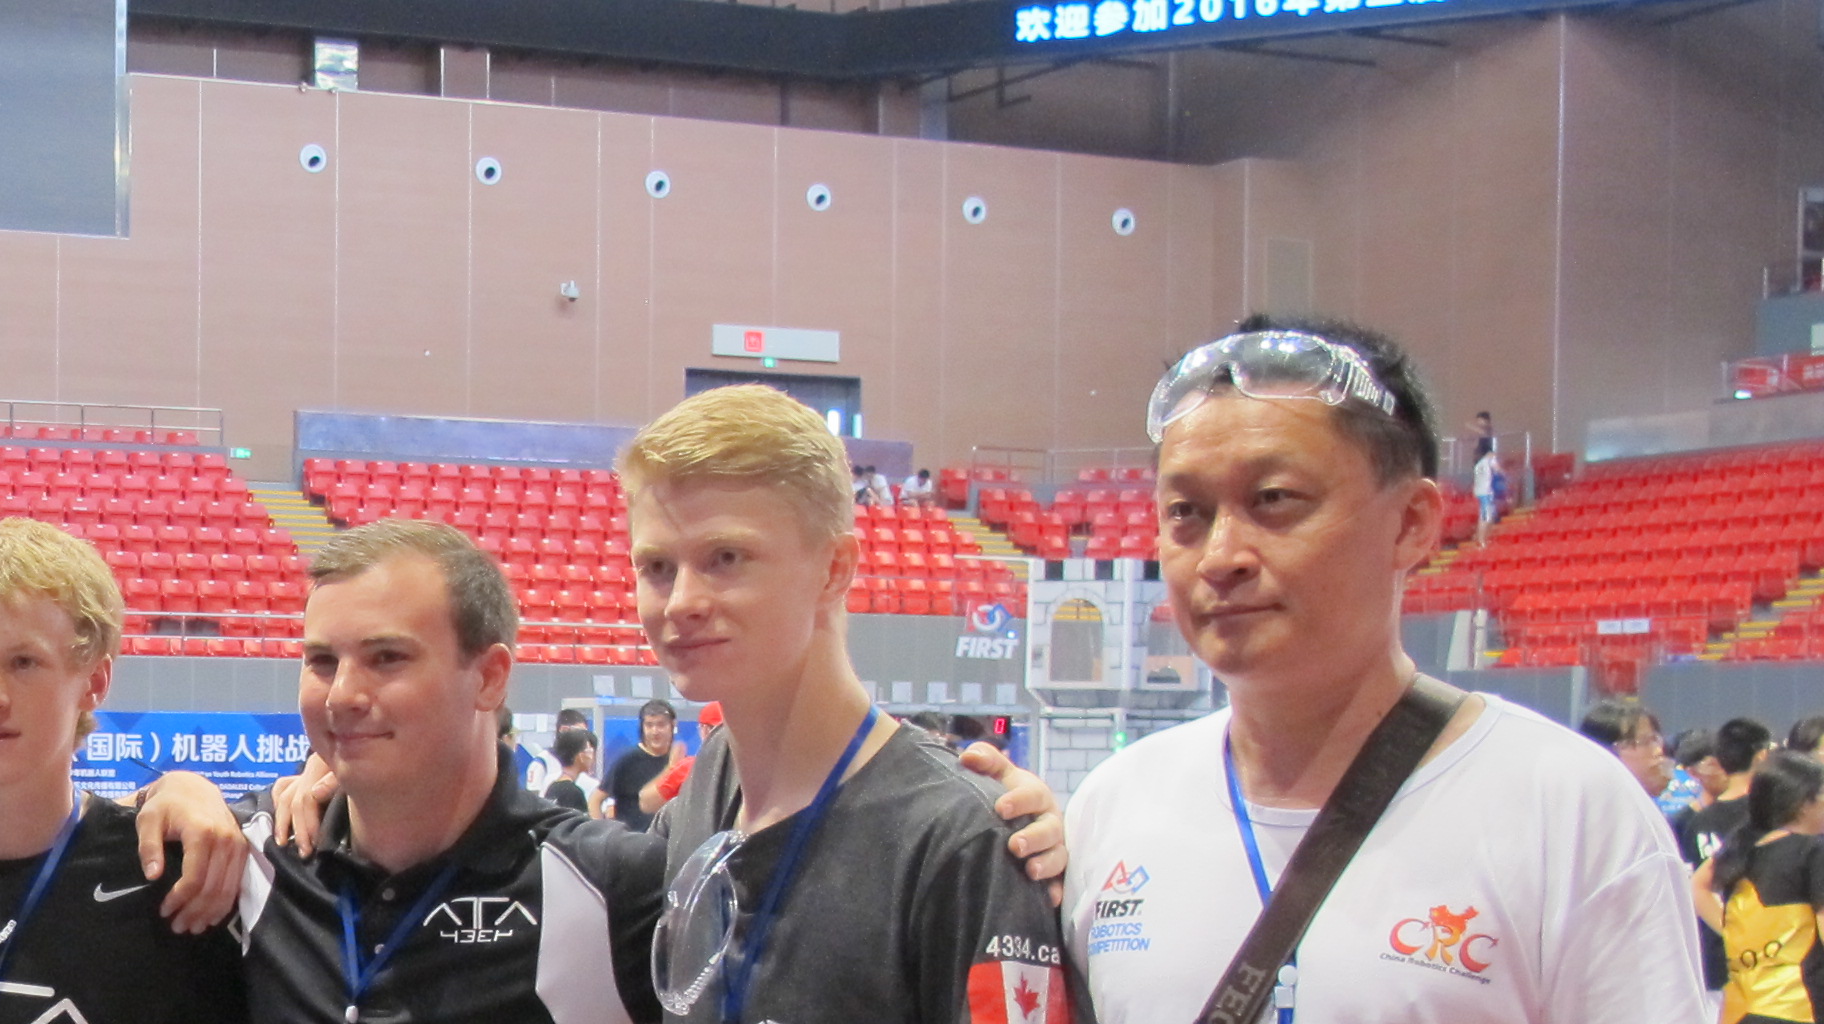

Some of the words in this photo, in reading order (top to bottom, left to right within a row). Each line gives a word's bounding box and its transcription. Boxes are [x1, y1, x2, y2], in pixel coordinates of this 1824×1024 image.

[955, 635, 1020, 660] FIRST
[72, 731, 312, 762] 国际）机器人挑战
[1095, 899, 1144, 920] FIRST
[1389, 917, 1499, 974] CRC
